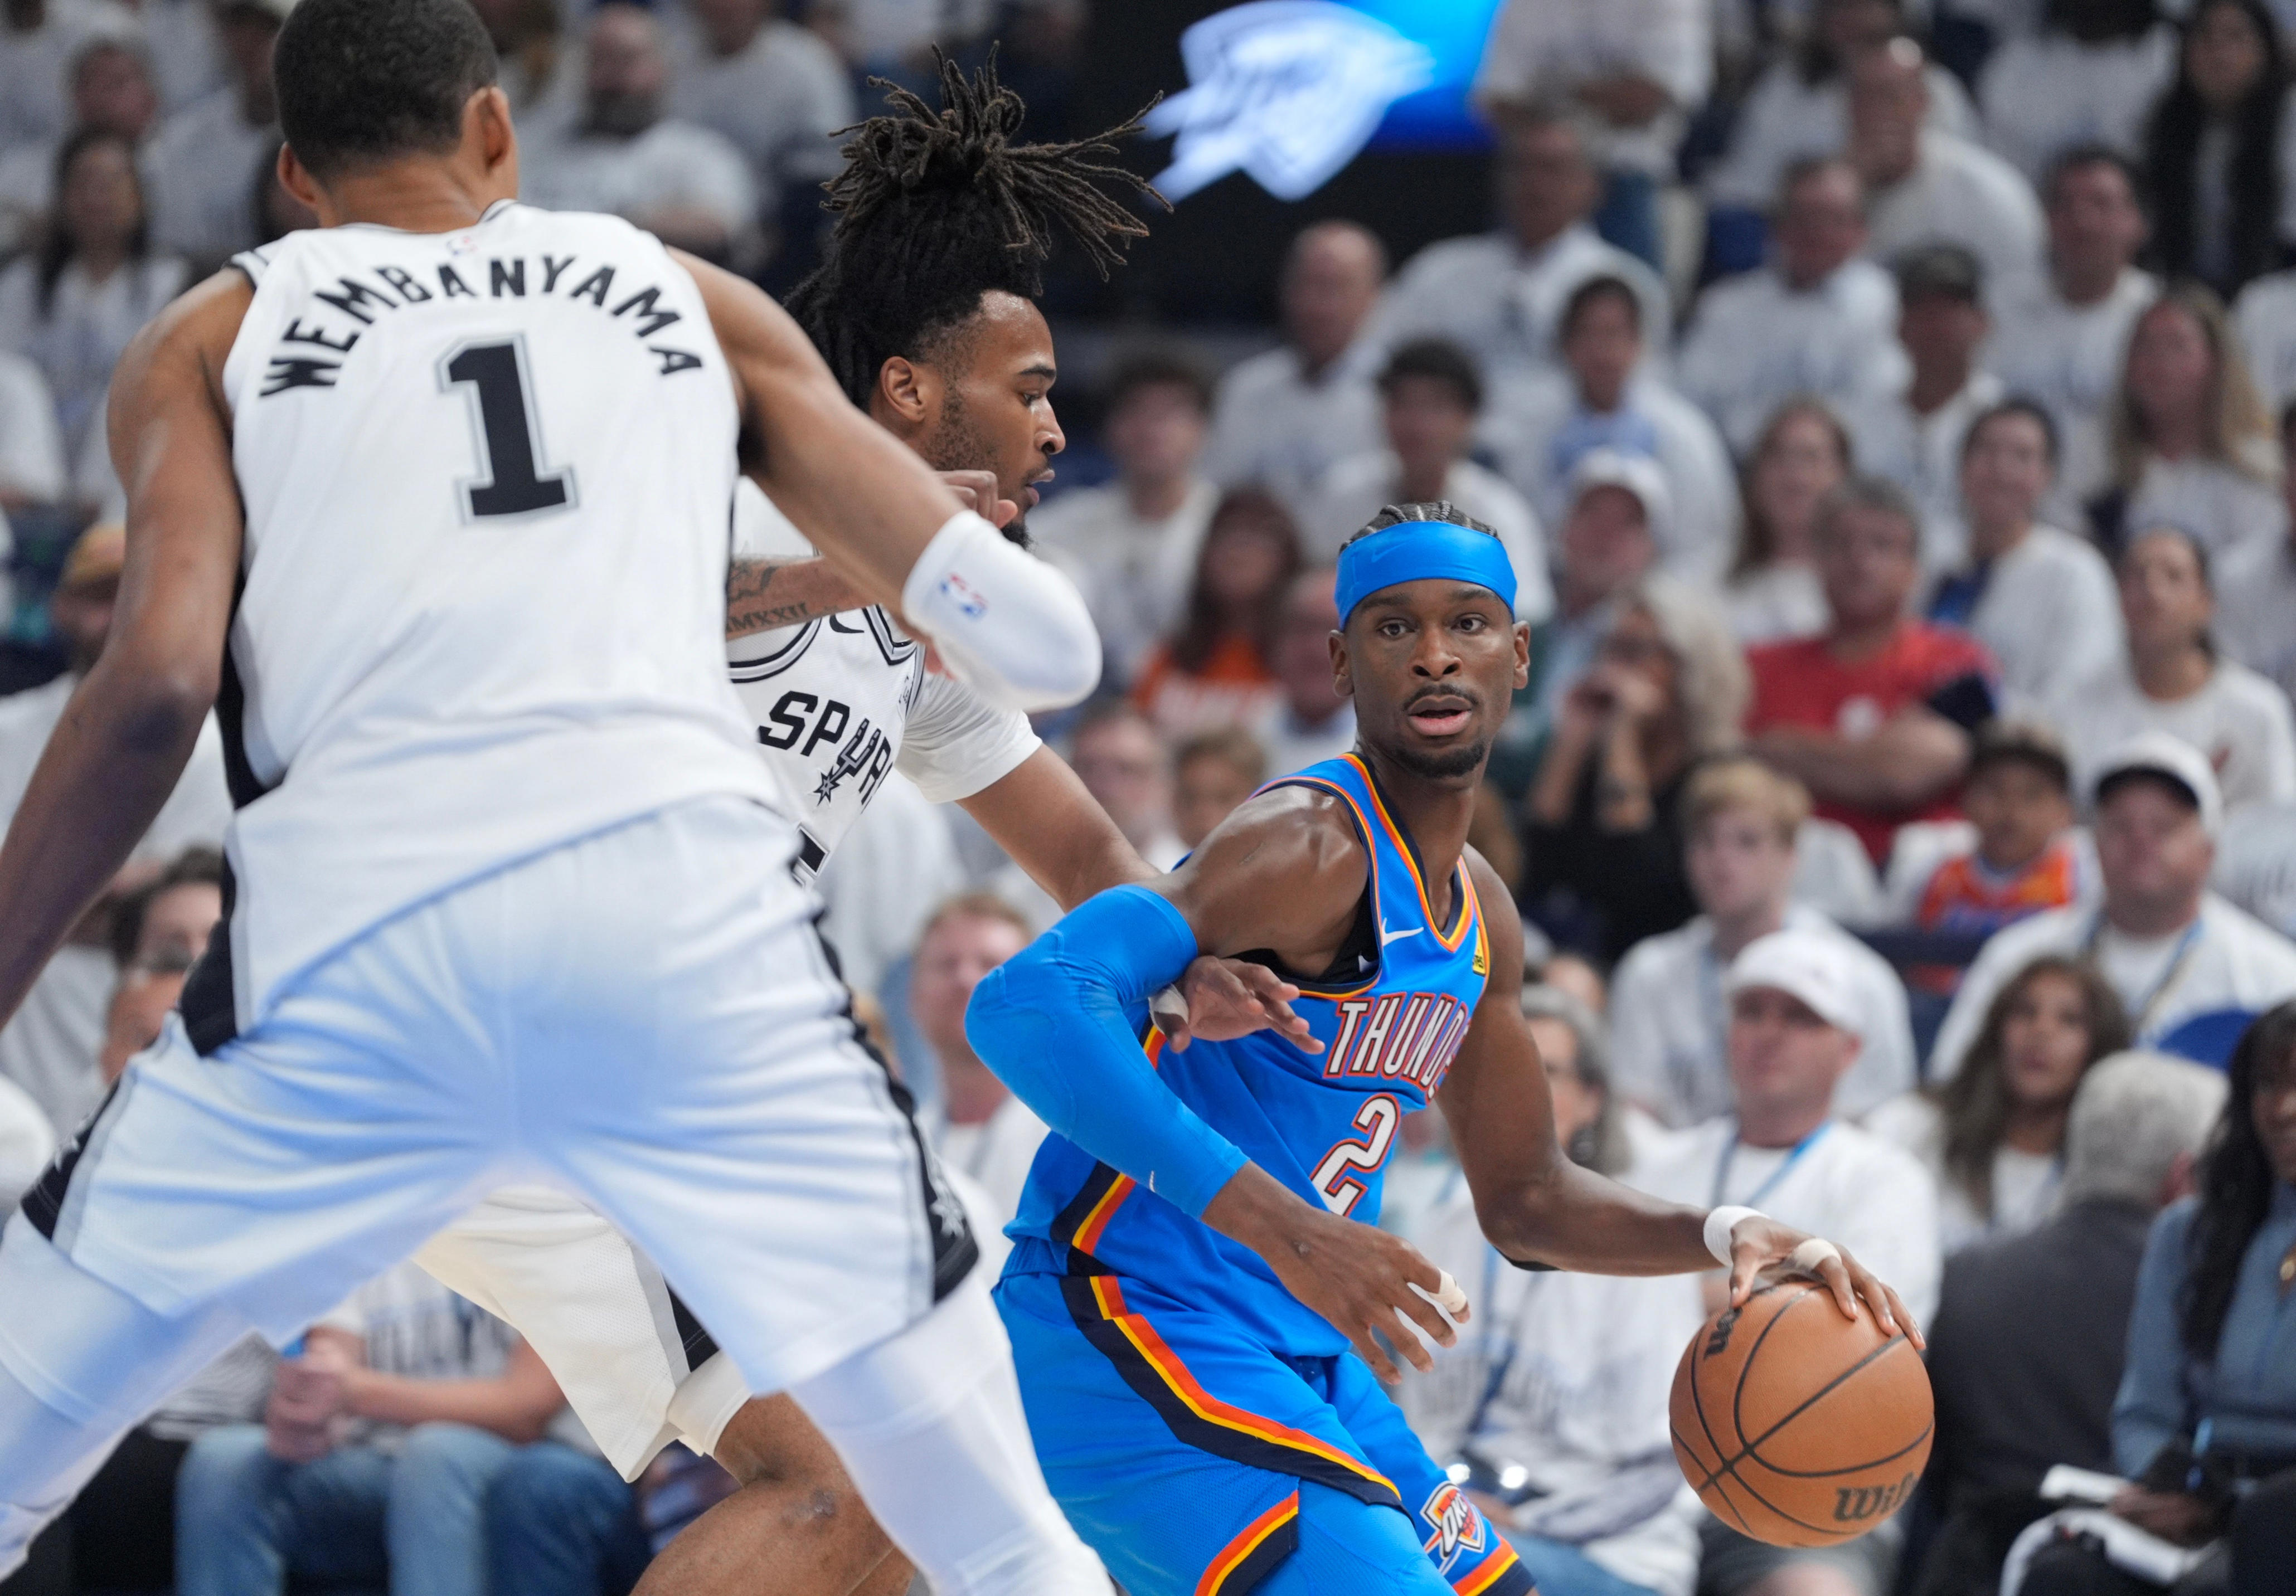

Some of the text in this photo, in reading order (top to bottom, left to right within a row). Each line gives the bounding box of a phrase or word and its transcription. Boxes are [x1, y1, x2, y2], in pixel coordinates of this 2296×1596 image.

[259, 255, 703, 398] WEMBANYAMA
[435, 333, 579, 524] 1
[757, 690, 893, 815] SPUR
[1310, 1093, 1400, 1217] 2
